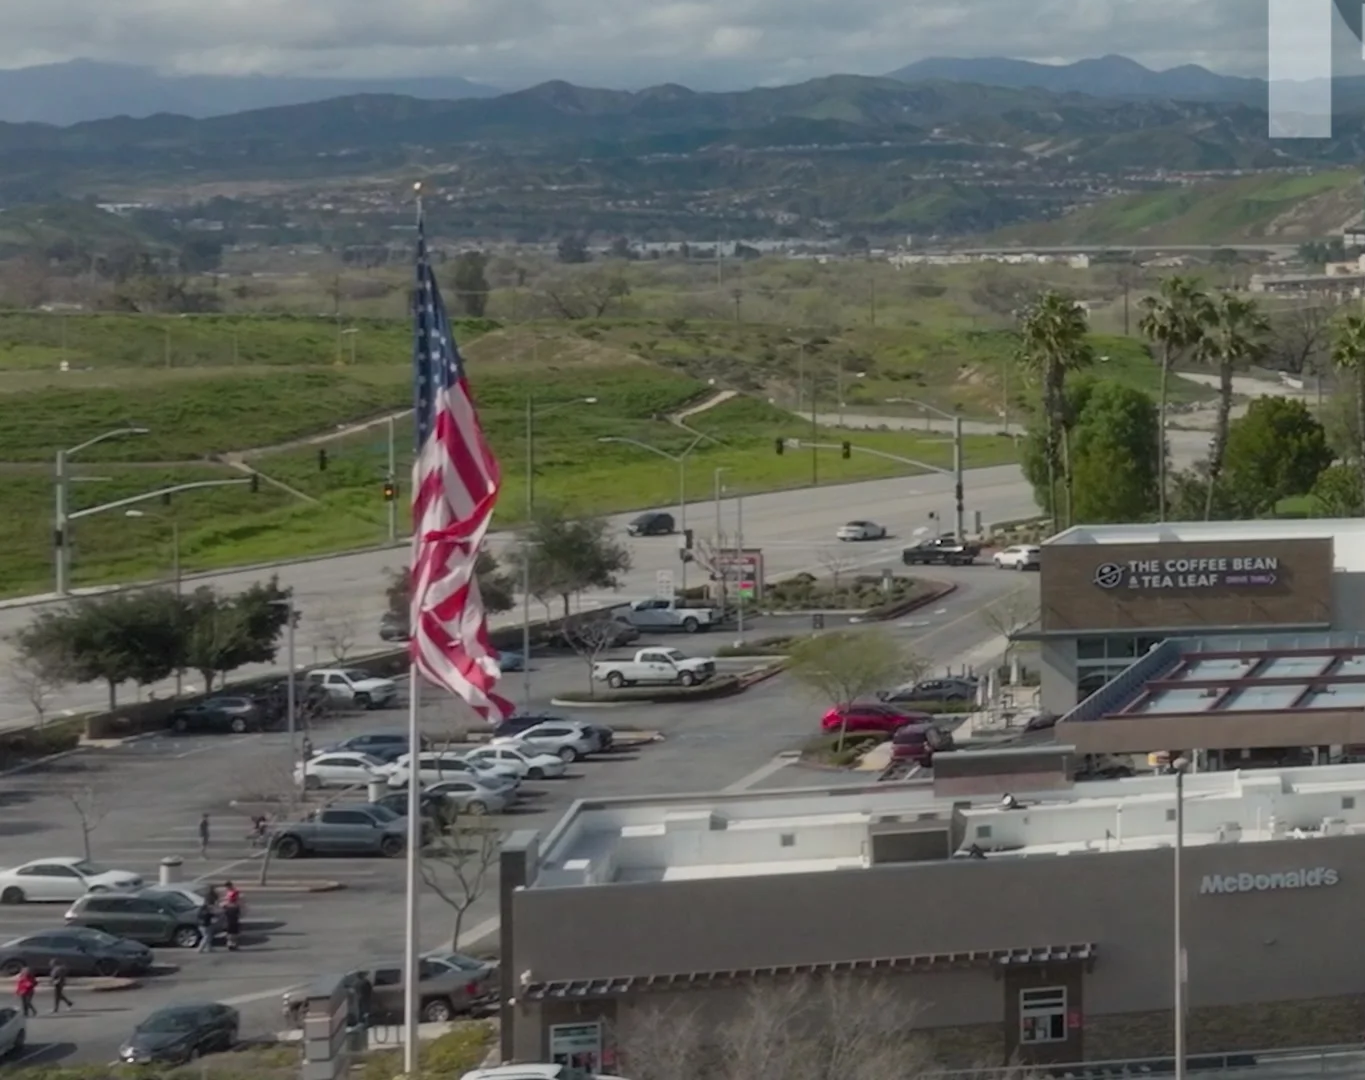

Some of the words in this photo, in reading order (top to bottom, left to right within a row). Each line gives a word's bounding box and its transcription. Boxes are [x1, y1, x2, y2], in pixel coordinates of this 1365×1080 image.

[1128, 560, 1160, 573] THE
[1165, 558, 1227, 572] COFFEE
[1232, 557, 1277, 570] BEAN
[1142, 575, 1174, 588] TEA
[1178, 574, 1219, 587] LEAF
[1200, 867, 1339, 894] McDonald's
